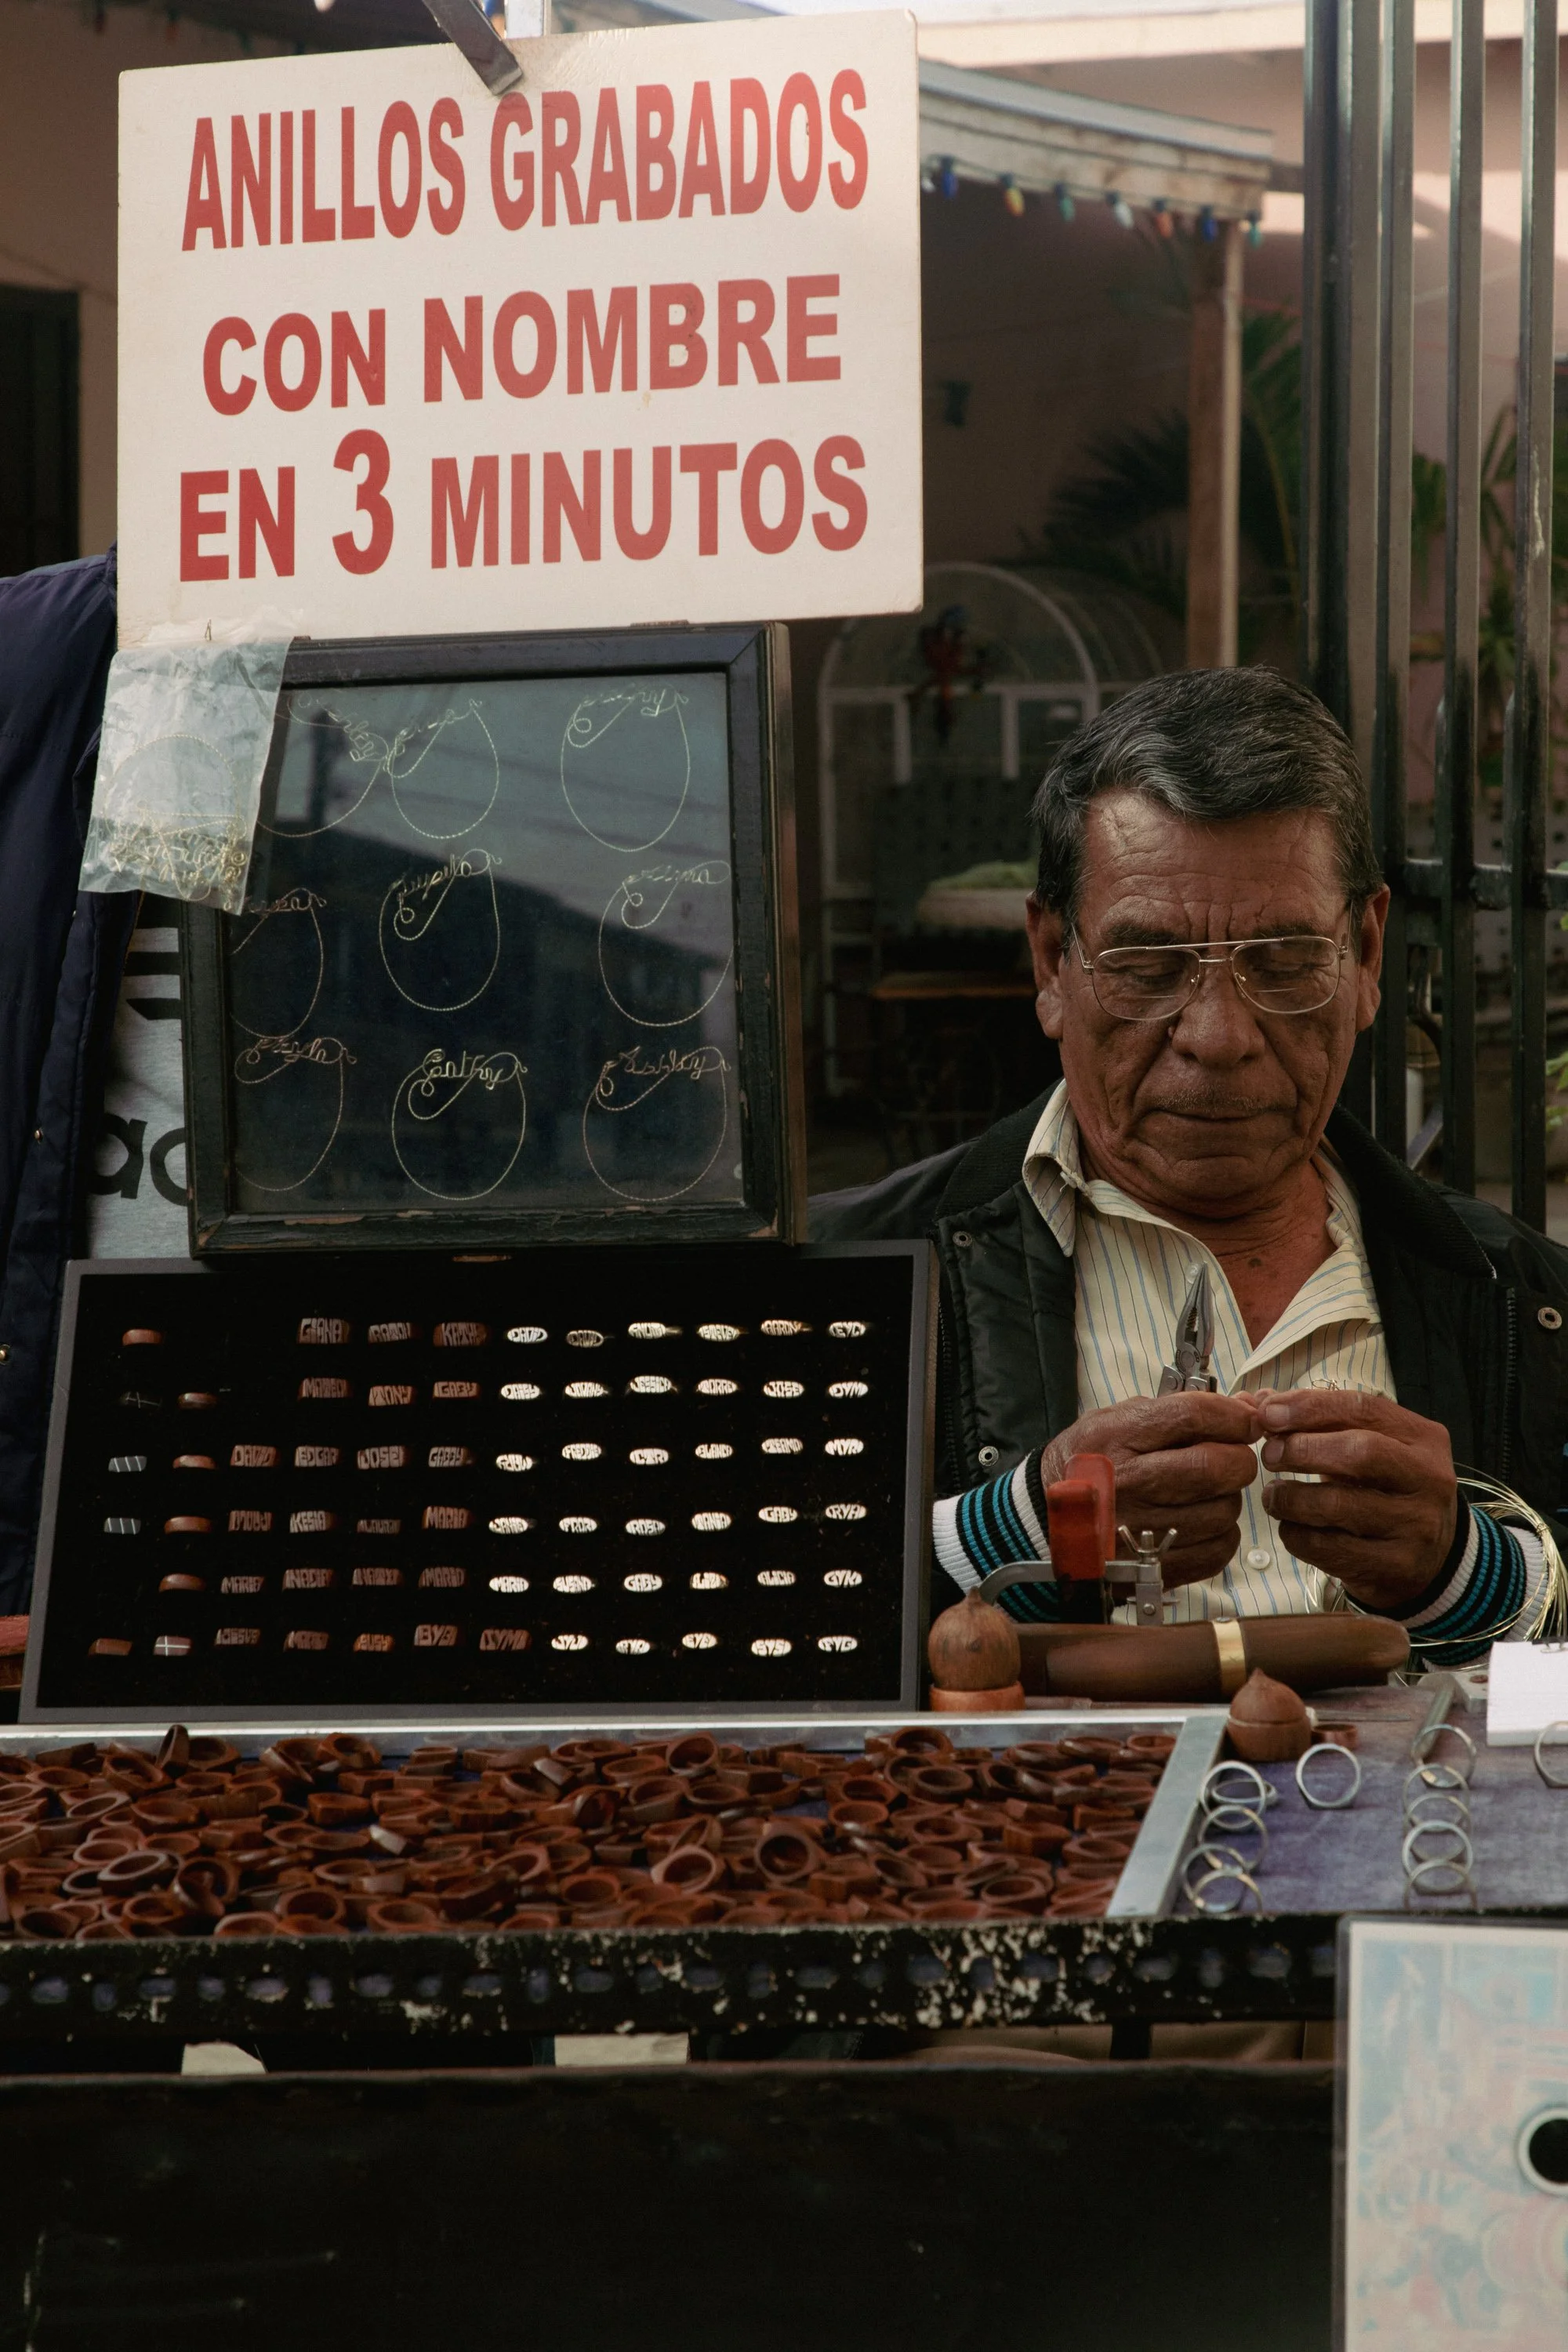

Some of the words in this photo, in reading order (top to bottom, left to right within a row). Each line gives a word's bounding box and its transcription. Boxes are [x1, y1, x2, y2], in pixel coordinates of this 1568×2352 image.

[181, 98, 466, 252] ANILLOS
[490, 69, 869, 231] GRABADOS
[203, 309, 386, 416] CON
[423, 274, 841, 402] NOMBRE
[180, 466, 296, 582] EN
[332, 429, 394, 575] 3
[431, 435, 868, 569] MINUTOS
[437, 1381, 478, 1398] GABY
[766, 1380, 801, 1399] JOSE
[298, 1446, 339, 1467] EDGAR
[761, 1506, 798, 1523] GABY
[623, 1573, 662, 1592] GABY
